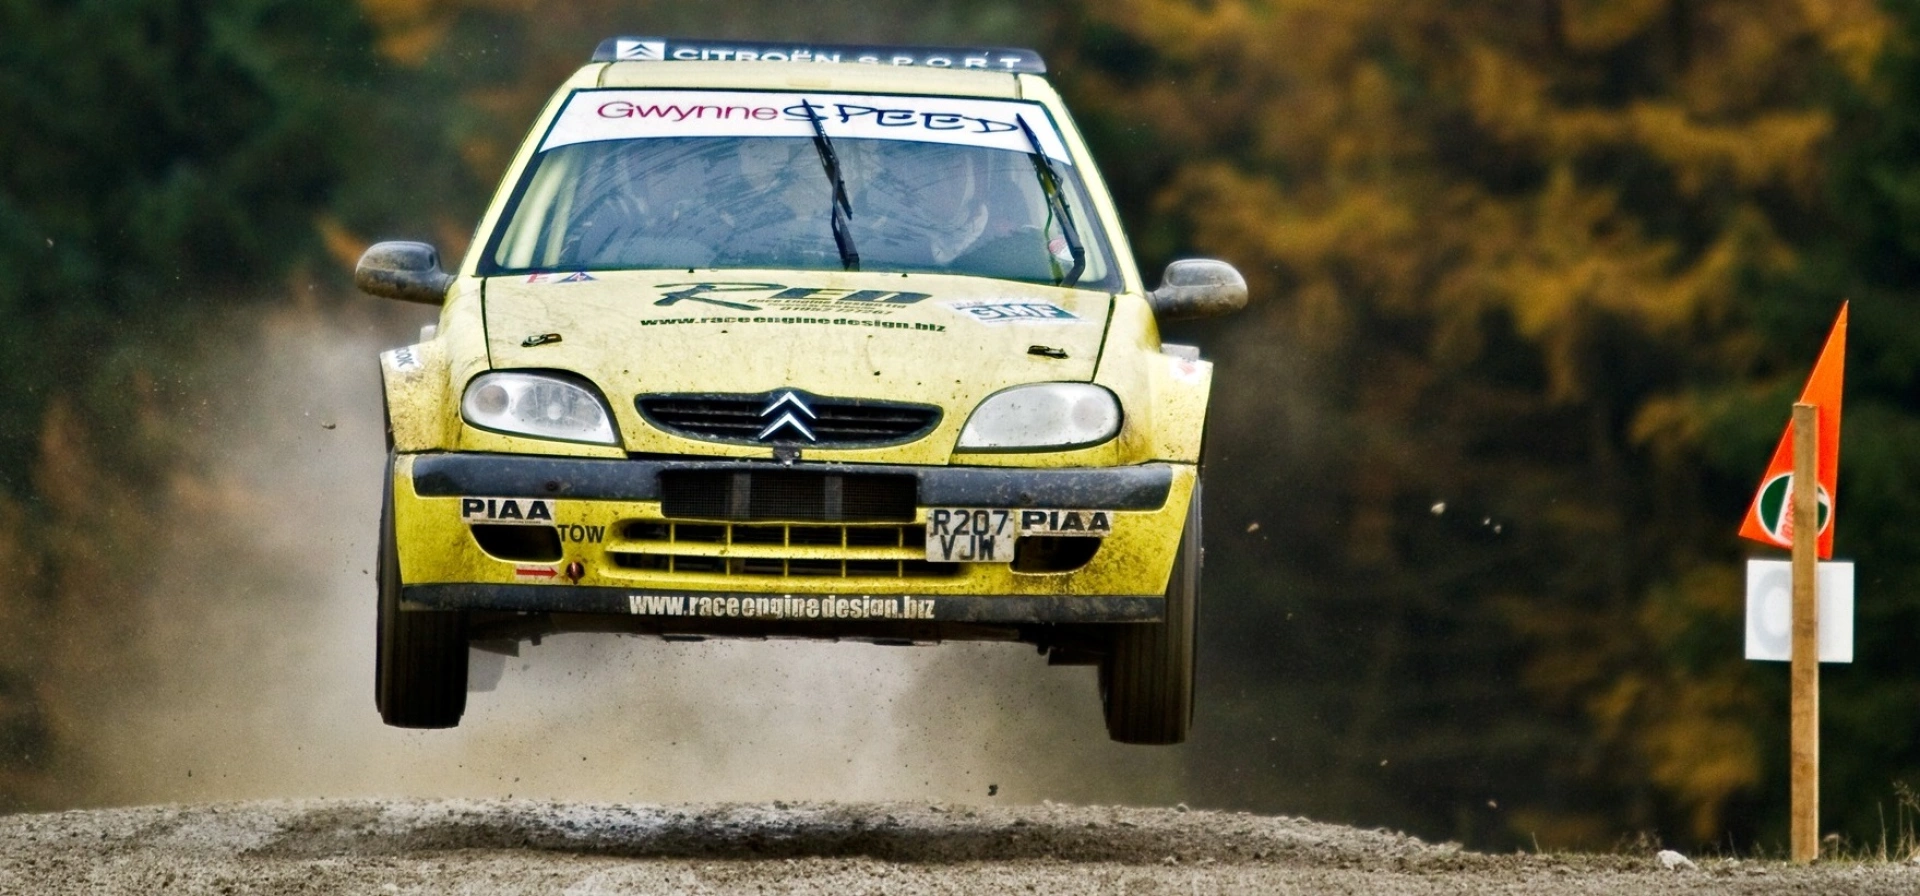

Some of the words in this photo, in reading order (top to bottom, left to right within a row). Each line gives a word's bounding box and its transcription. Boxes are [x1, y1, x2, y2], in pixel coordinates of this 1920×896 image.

[858, 54, 1021, 69] SPORT
[597, 101, 778, 122] Gwynne
[462, 498, 552, 520] PIAA
[933, 509, 1009, 536] R207
[1021, 510, 1110, 531] PIAA
[557, 524, 606, 543] TOW
[940, 534, 995, 561] VJW
